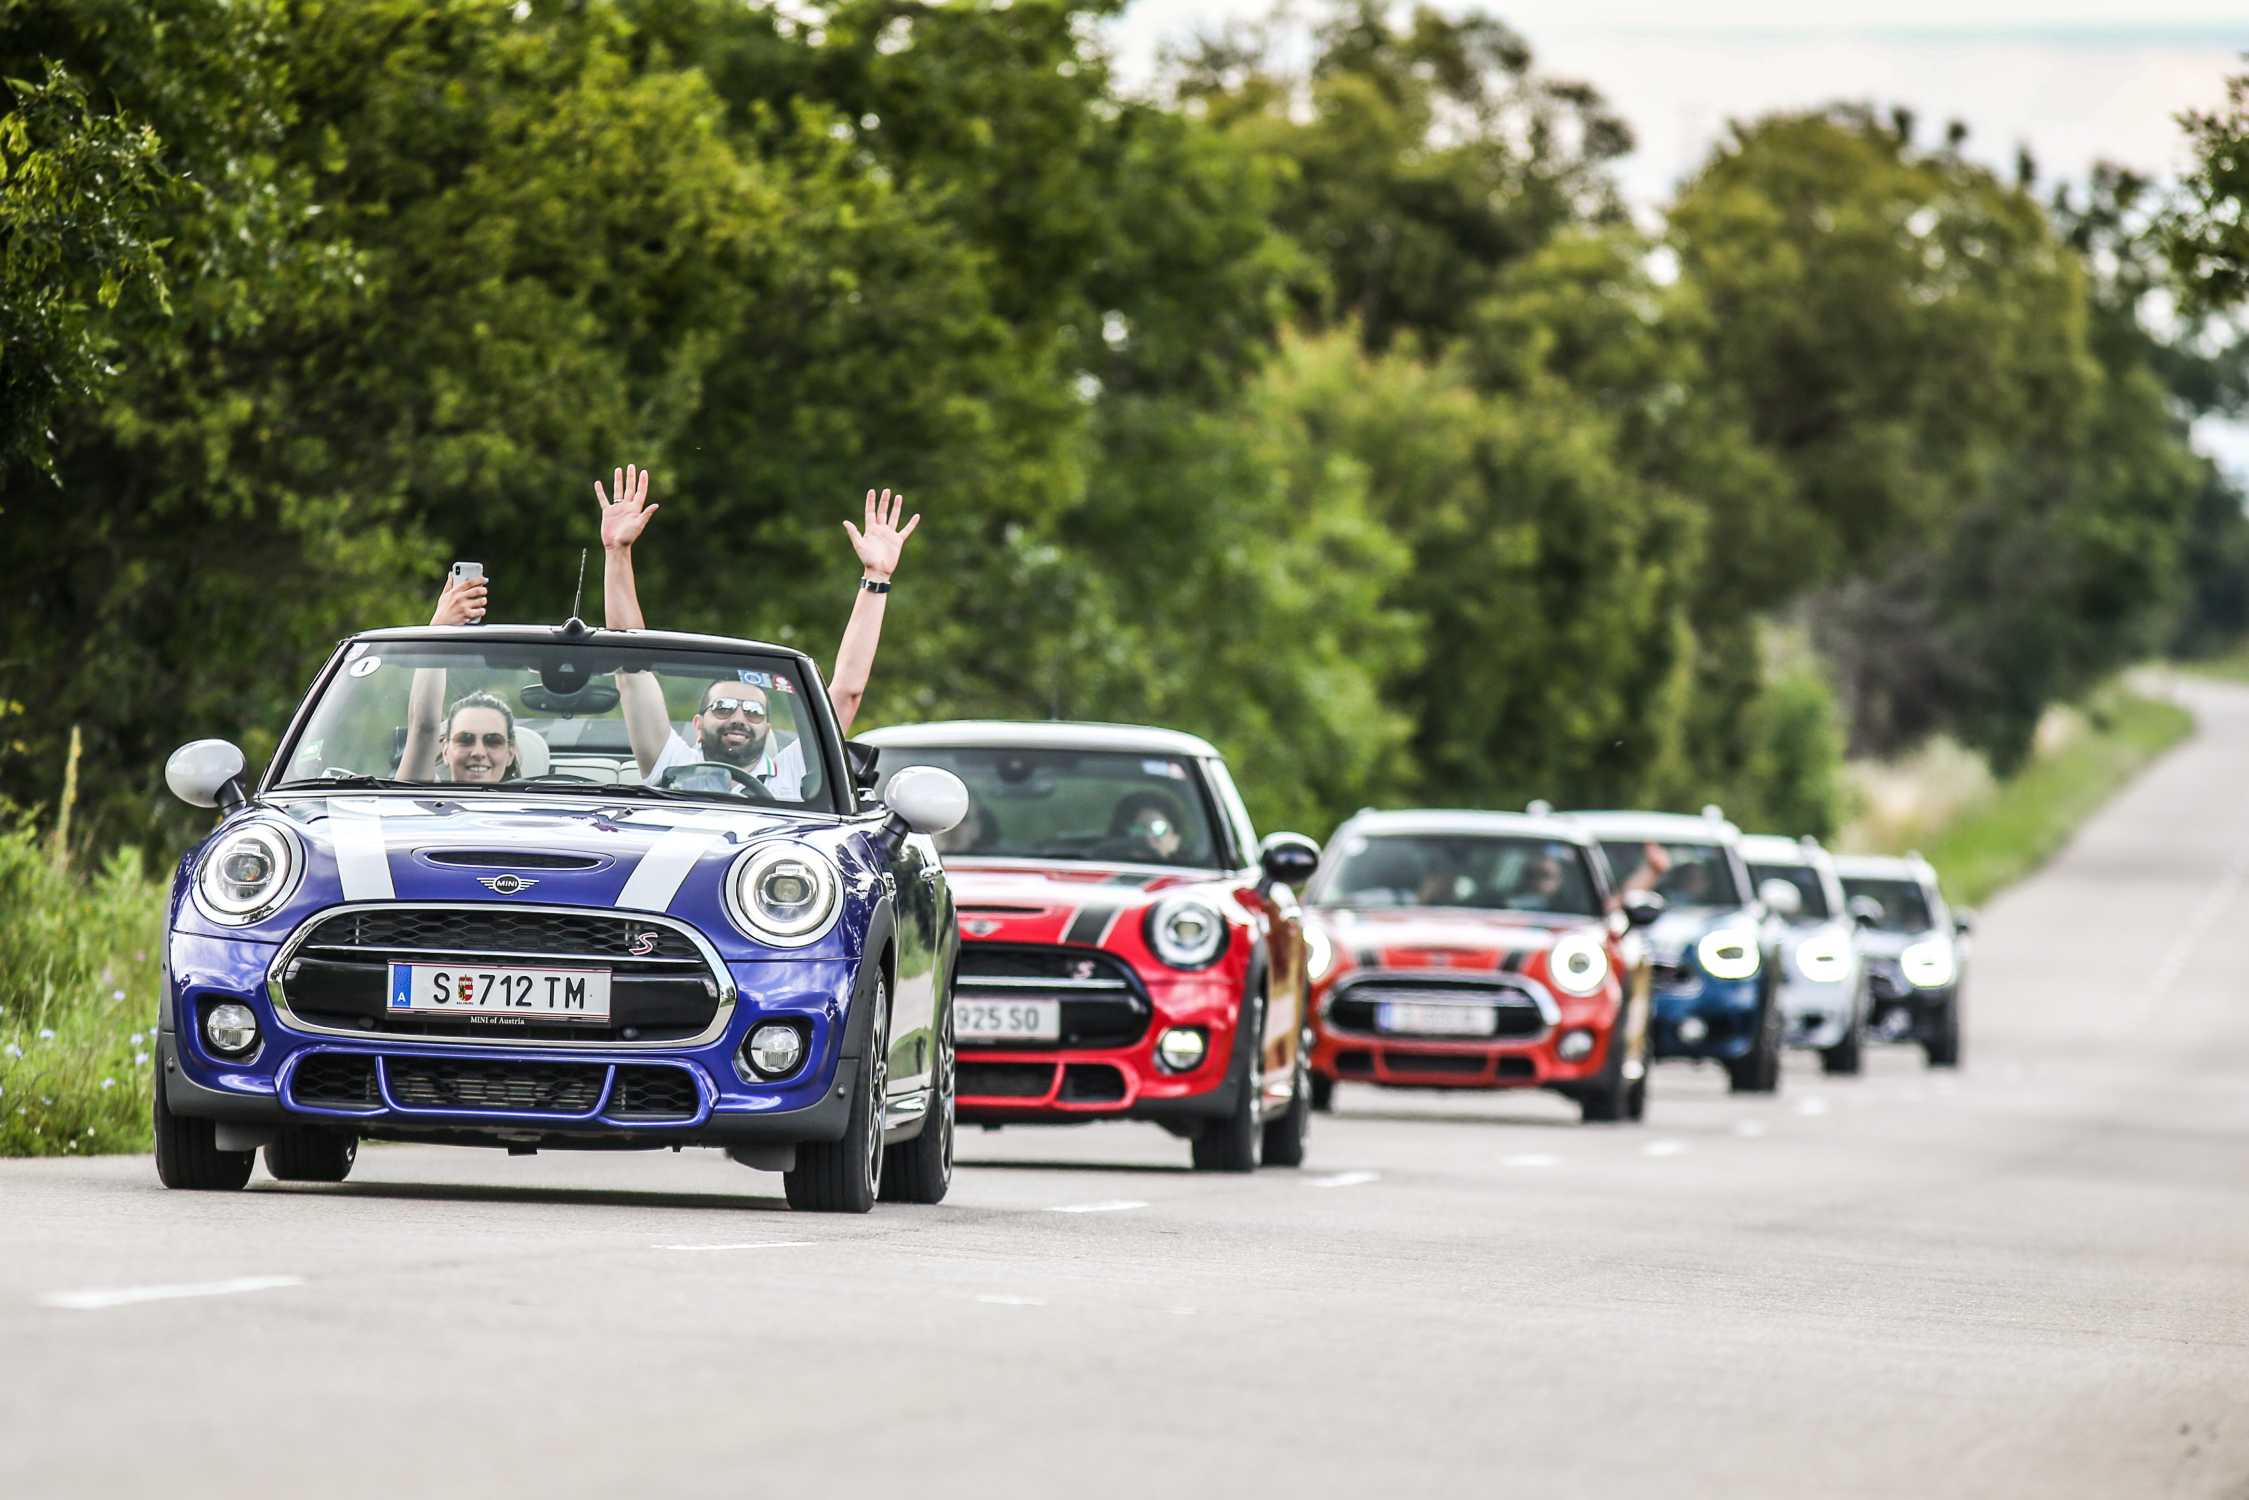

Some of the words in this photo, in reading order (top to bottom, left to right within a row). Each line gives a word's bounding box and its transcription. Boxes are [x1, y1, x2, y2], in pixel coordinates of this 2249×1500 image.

[496, 880, 518, 888] MINI
[628, 932, 658, 956] S
[433, 972, 450, 1004] S
[478, 974, 533, 1006] 712
[544, 976, 585, 1009] TM
[396, 992, 406, 1003] A
[470, 1016, 489, 1024] MINI
[499, 1017, 525, 1025] Austria
